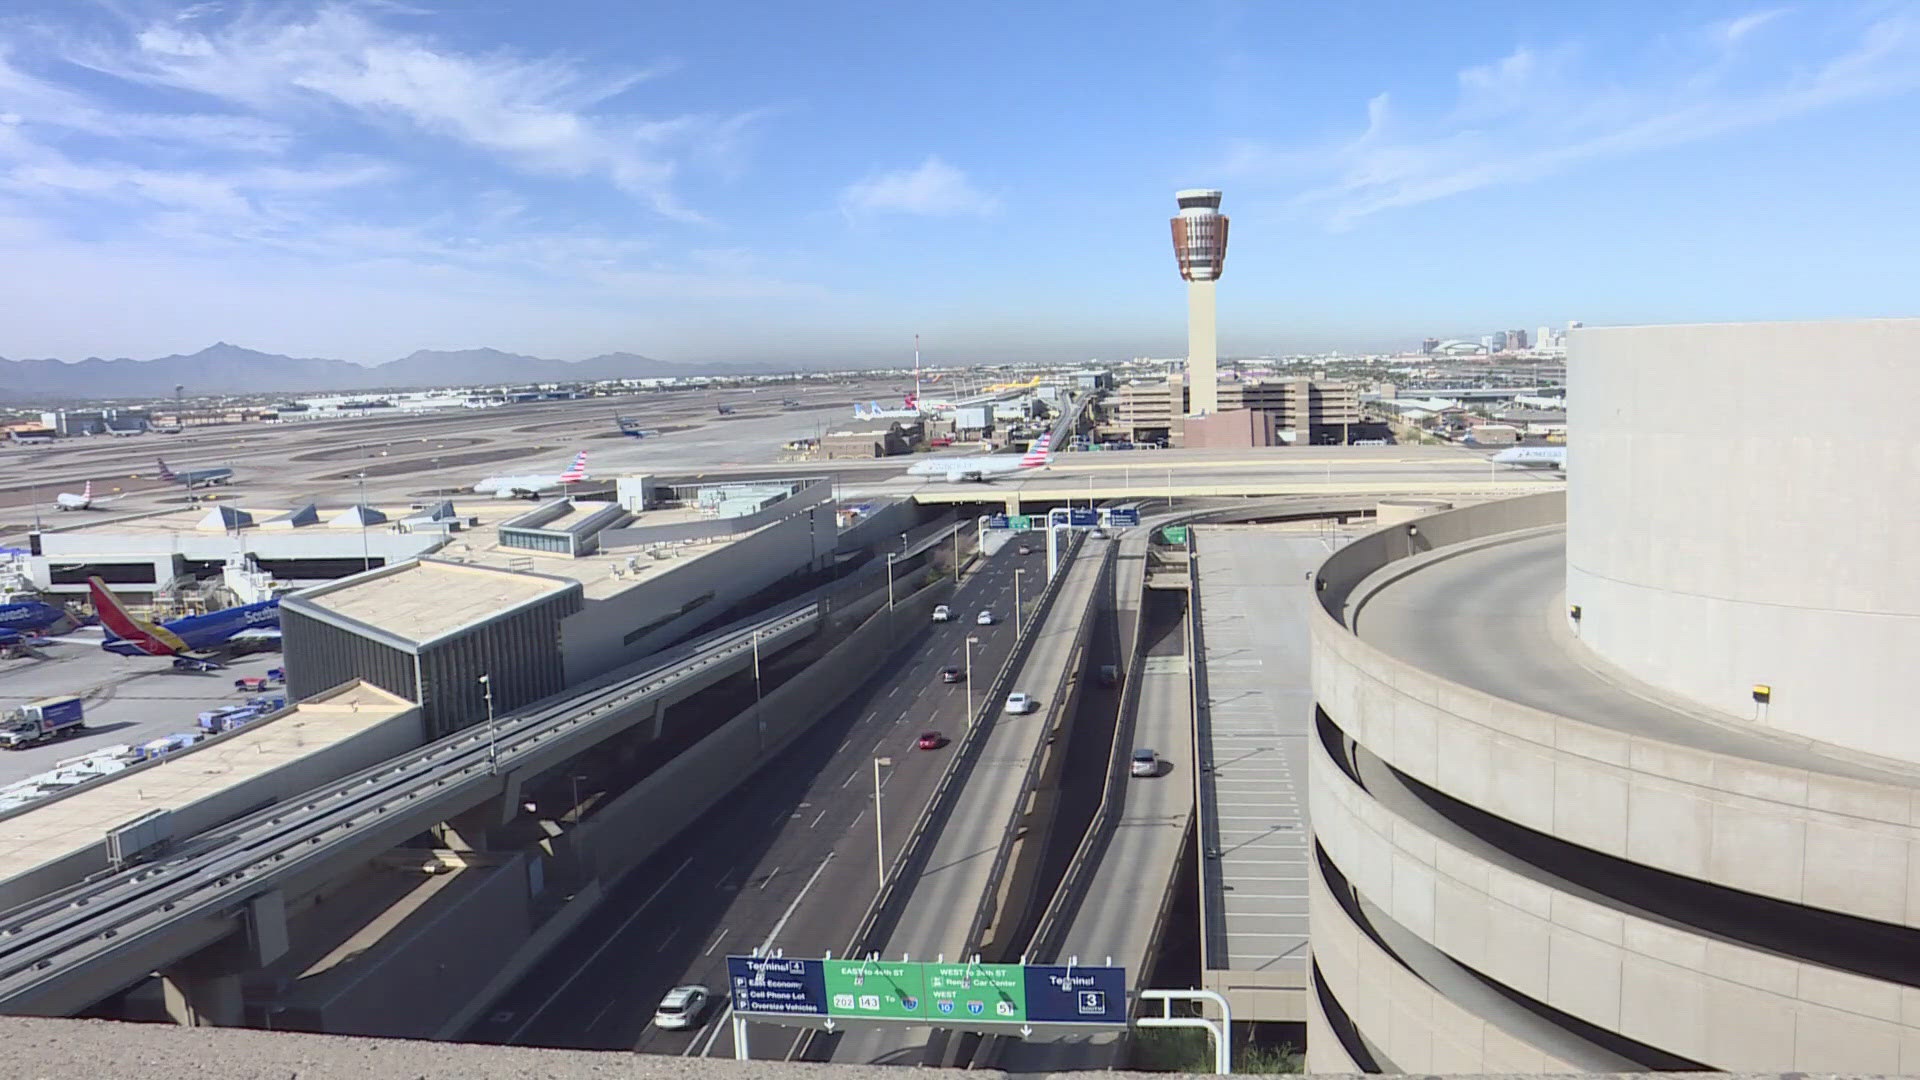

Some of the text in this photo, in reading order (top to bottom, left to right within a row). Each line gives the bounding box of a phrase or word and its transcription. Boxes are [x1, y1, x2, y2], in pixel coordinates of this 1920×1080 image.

[767, 980, 803, 989] Economy
[1049, 975, 1094, 986] Teminal
[792, 992, 806, 1000] Lot
[885, 995, 896, 1003] To
[1087, 994, 1097, 1006] 3
[835, 998, 853, 1006] 202
[861, 999, 878, 1007] 143
[751, 1002, 817, 1012] Oversize Vehicles
